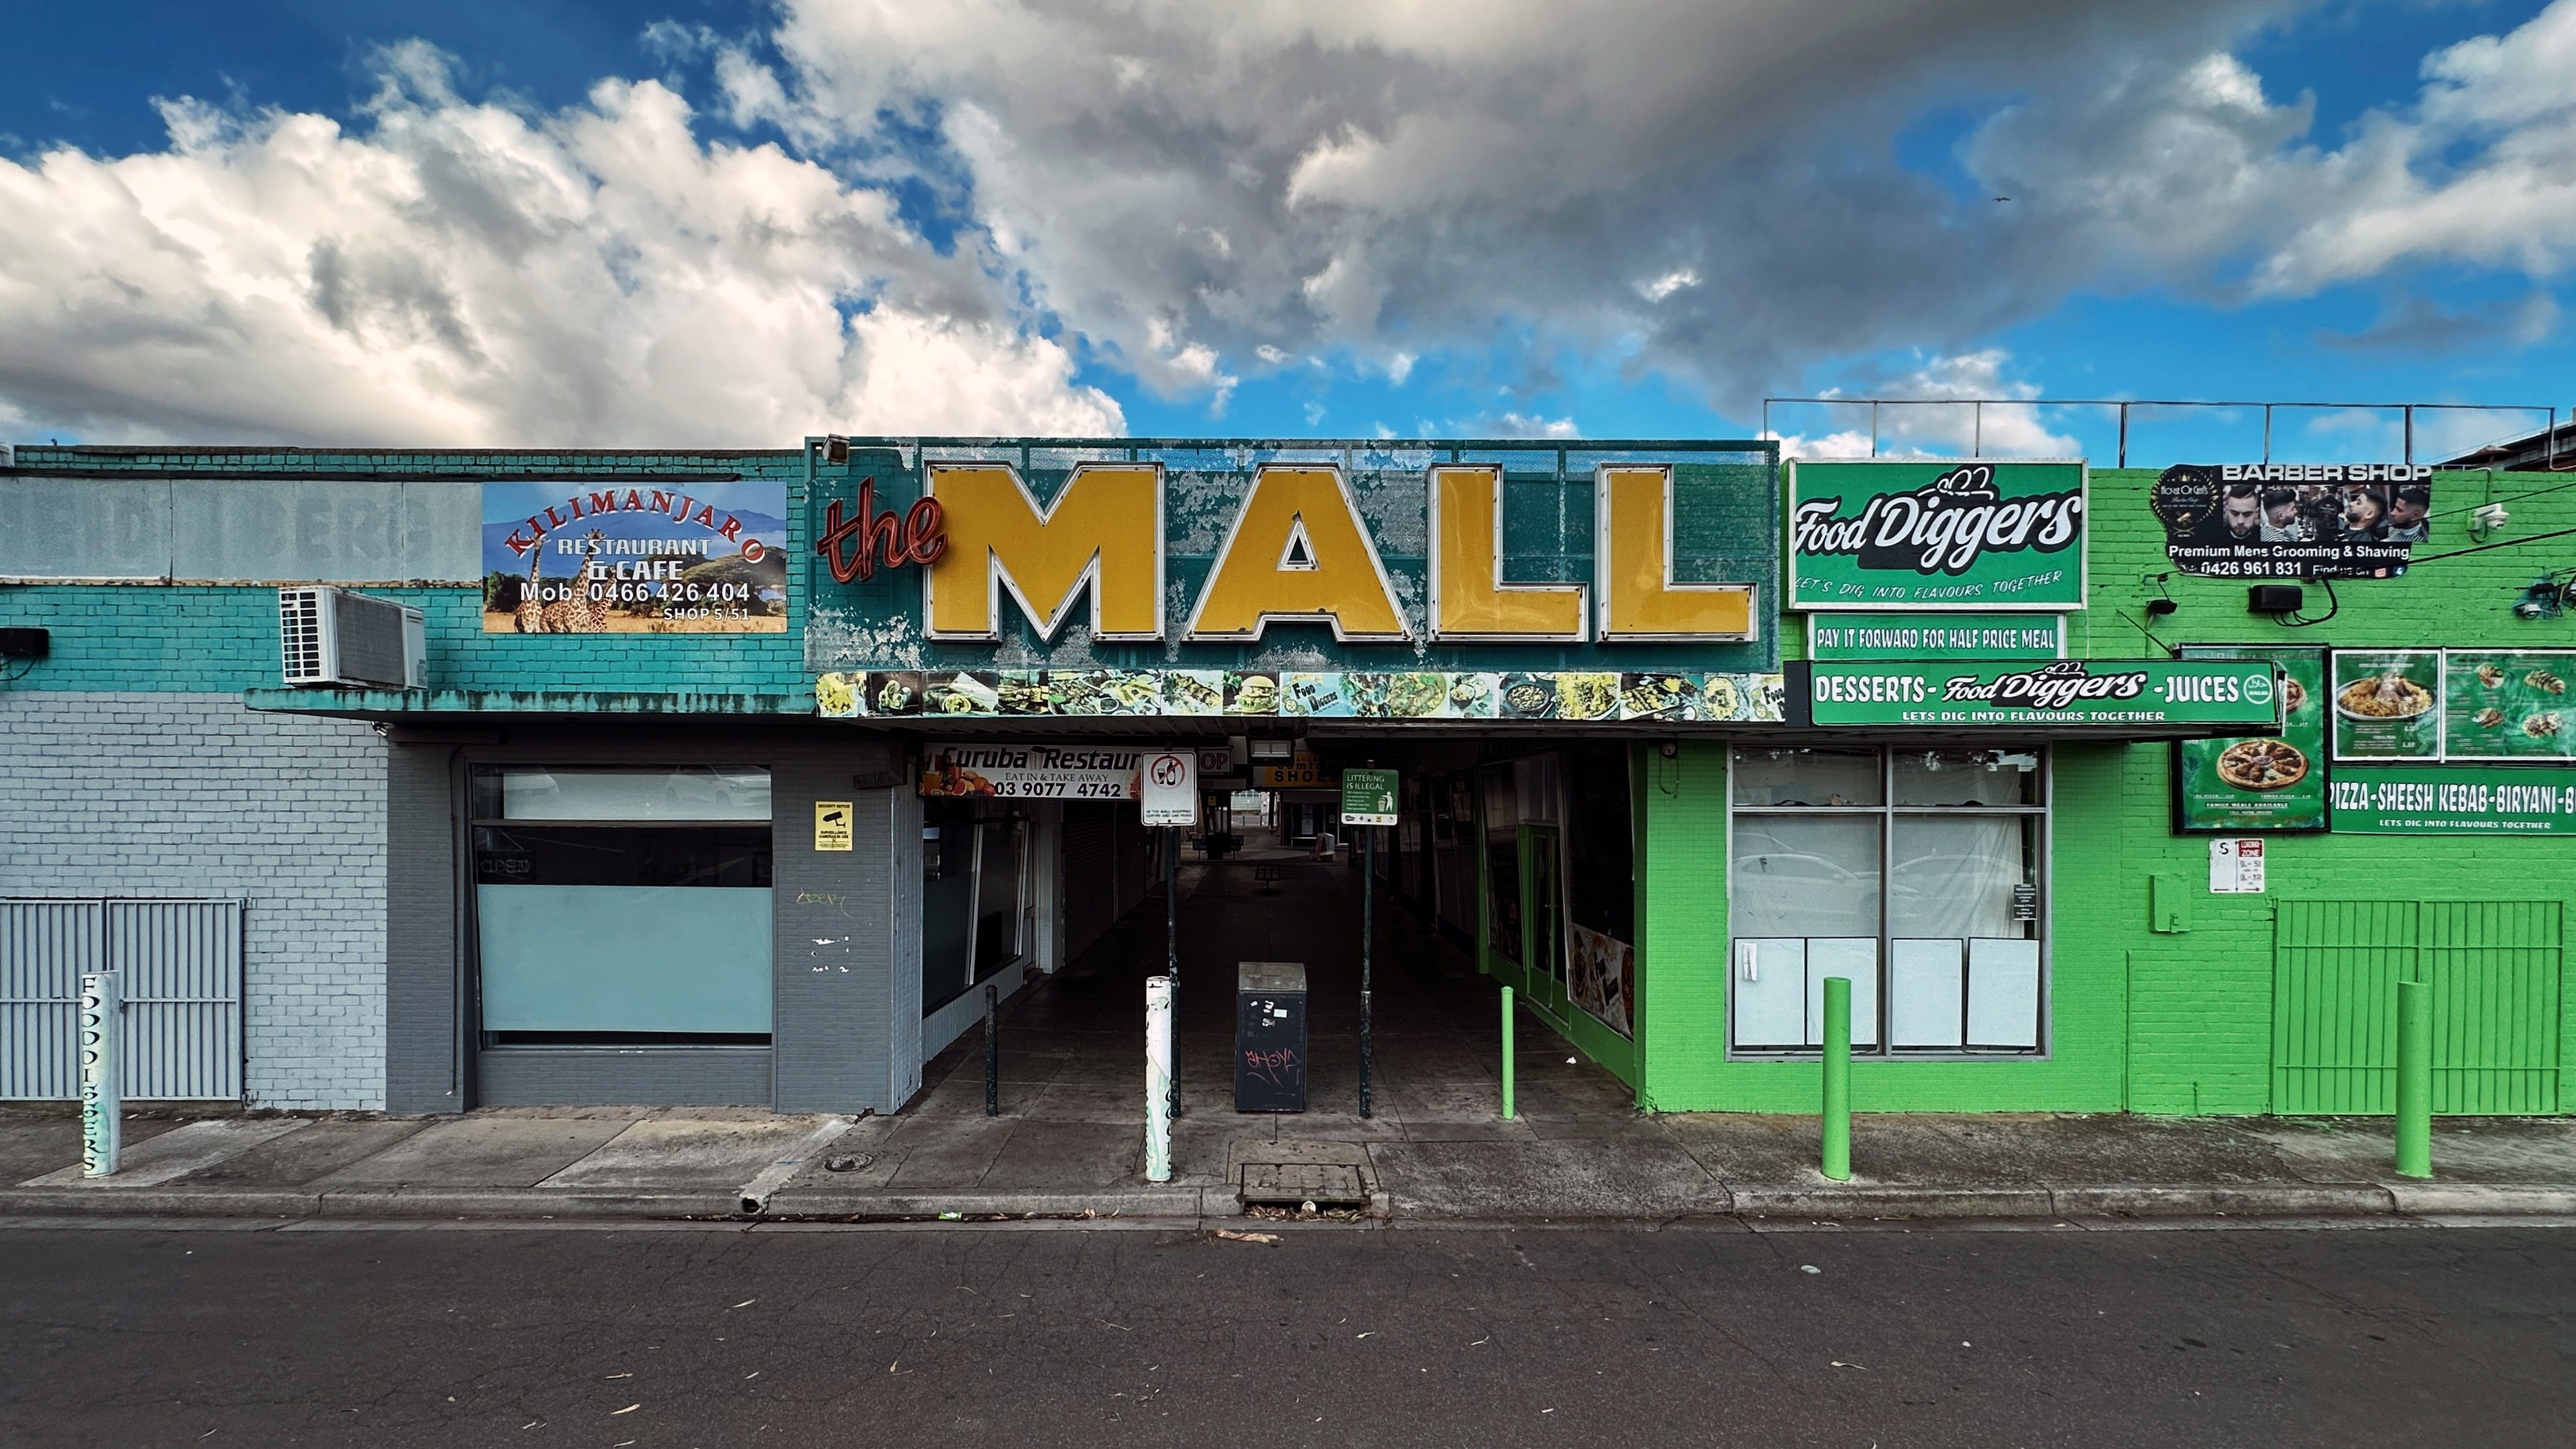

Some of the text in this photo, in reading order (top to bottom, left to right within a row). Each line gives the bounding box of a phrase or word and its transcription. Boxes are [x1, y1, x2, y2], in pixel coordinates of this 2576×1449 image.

[2222, 465, 2432, 481] BARBER SHOP
[505, 489, 765, 563] KILIMANJARO
[817, 475, 948, 584] the
[1795, 496, 2081, 569] Food Diggers
[558, 539, 711, 555] RESTAURANT
[921, 460, 1758, 643] MALL
[2169, 545, 2409, 560] Premium Mens Grooming & Shaving
[587, 560, 683, 580] & CAFE
[2201, 562, 2240, 576] 0426
[2243, 562, 2270, 576] 961
[2275, 562, 2301, 575] 831
[590, 583, 649, 601] 0466
[656, 583, 699, 601] 426
[706, 583, 750, 601] 404
[1795, 571, 2063, 599] LET'S DIG INTO FLAVOURS TOGETHER
[663, 608, 750, 622] SHOP 5/51
[1817, 628, 2055, 649] PAY IT FORWARD FOR HALF PRICE MEAL
[1942, 675, 2007, 702] Food
[2001, 674, 2147, 707] Diggers
[1903, 711, 2165, 721] LETS DIG INTO FLAVOURS TOGETHER
[942, 746, 1142, 770] Curuba Restaur
[1005, 772, 1109, 782] EAT IN & TAKE AWAY
[1347, 774, 1385, 783] LITTERING
[994, 781, 1121, 797] 03 9077 4742
[2502, 821, 2551, 830] TOGETHER
